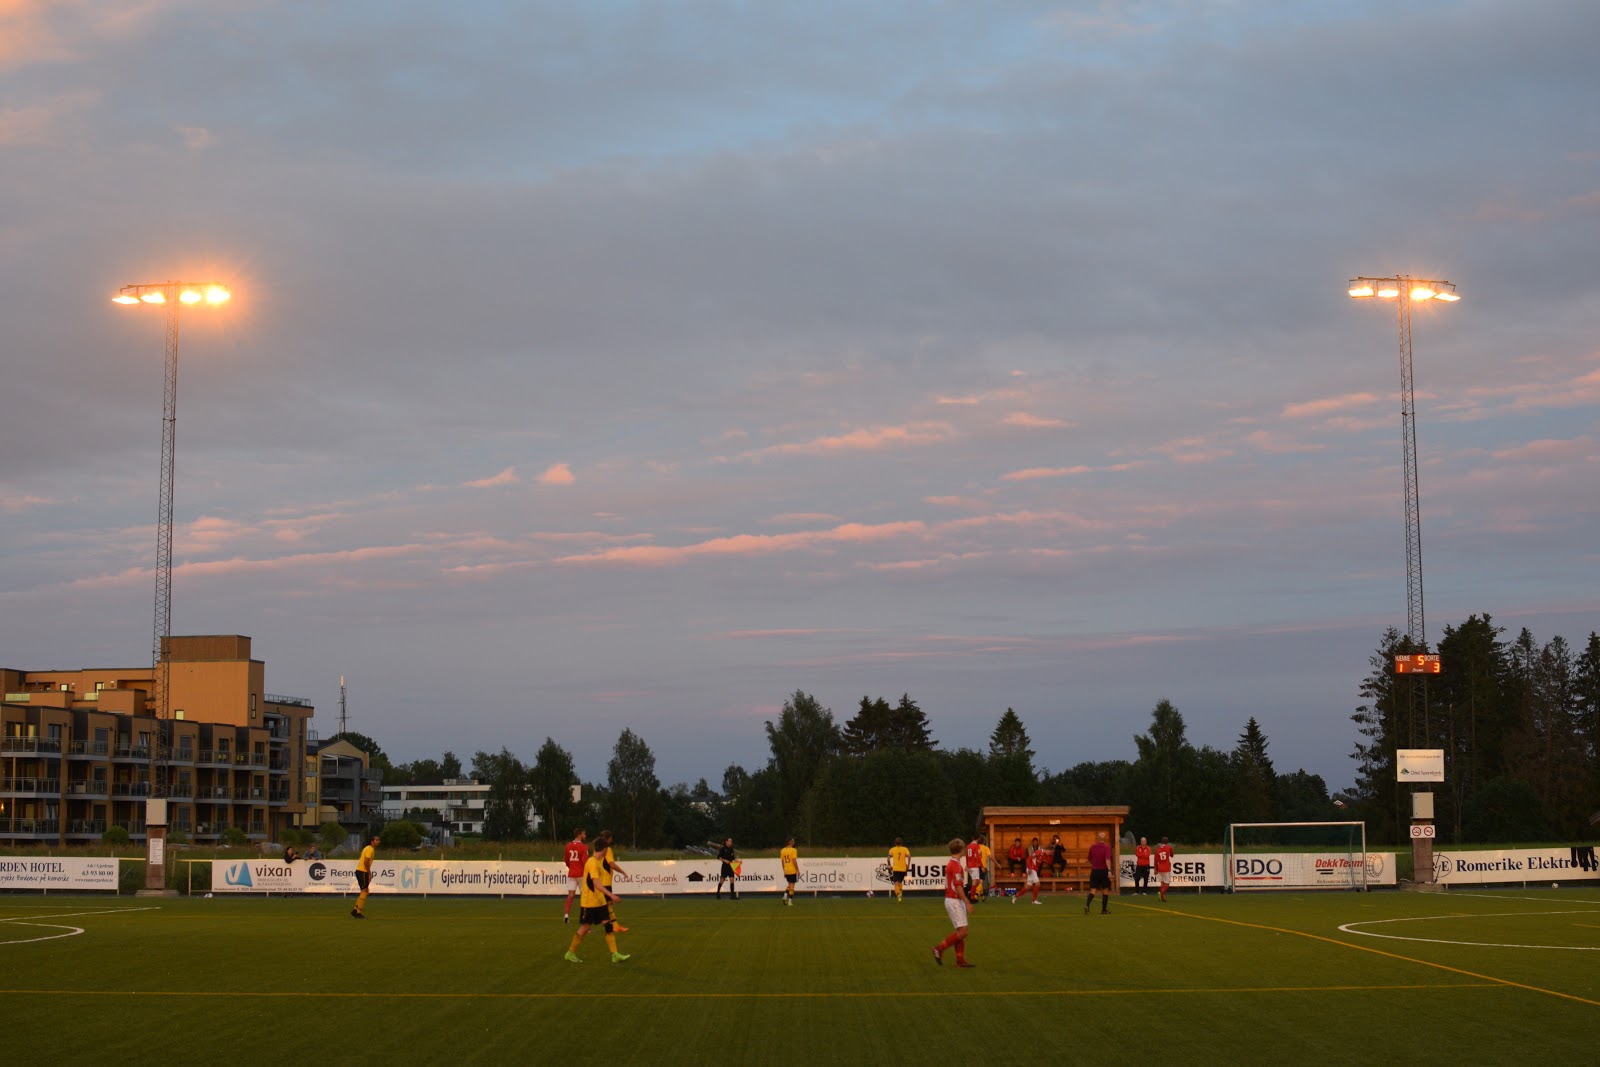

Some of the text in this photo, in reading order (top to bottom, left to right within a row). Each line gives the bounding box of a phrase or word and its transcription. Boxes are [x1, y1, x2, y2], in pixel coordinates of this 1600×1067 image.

[1417, 655, 1425, 665] 5
[1399, 663, 1403, 672] 1
[1433, 662, 1440, 672] 3
[569, 850, 579, 861] 22
[784, 855, 790, 863] 15
[1159, 851, 1166, 860] 15
[0, 862, 65, 872] RDEN HOTEL
[1236, 859, 1283, 875] BDO
[1456, 858, 1523, 872] Romerike
[1527, 856, 1578, 870] Elektr
[255, 864, 292, 877] vixan
[330, 869, 395, 878] Regnp AS
[906, 864, 946, 877] HUS
[441, 869, 567, 888] Gjerdrum Fysioterapi & Trenin
[636, 873, 678, 884] Sparebank
[706, 872, 775, 882] Joh ranås a.s
[903, 878, 945, 886] ENTREPRE
